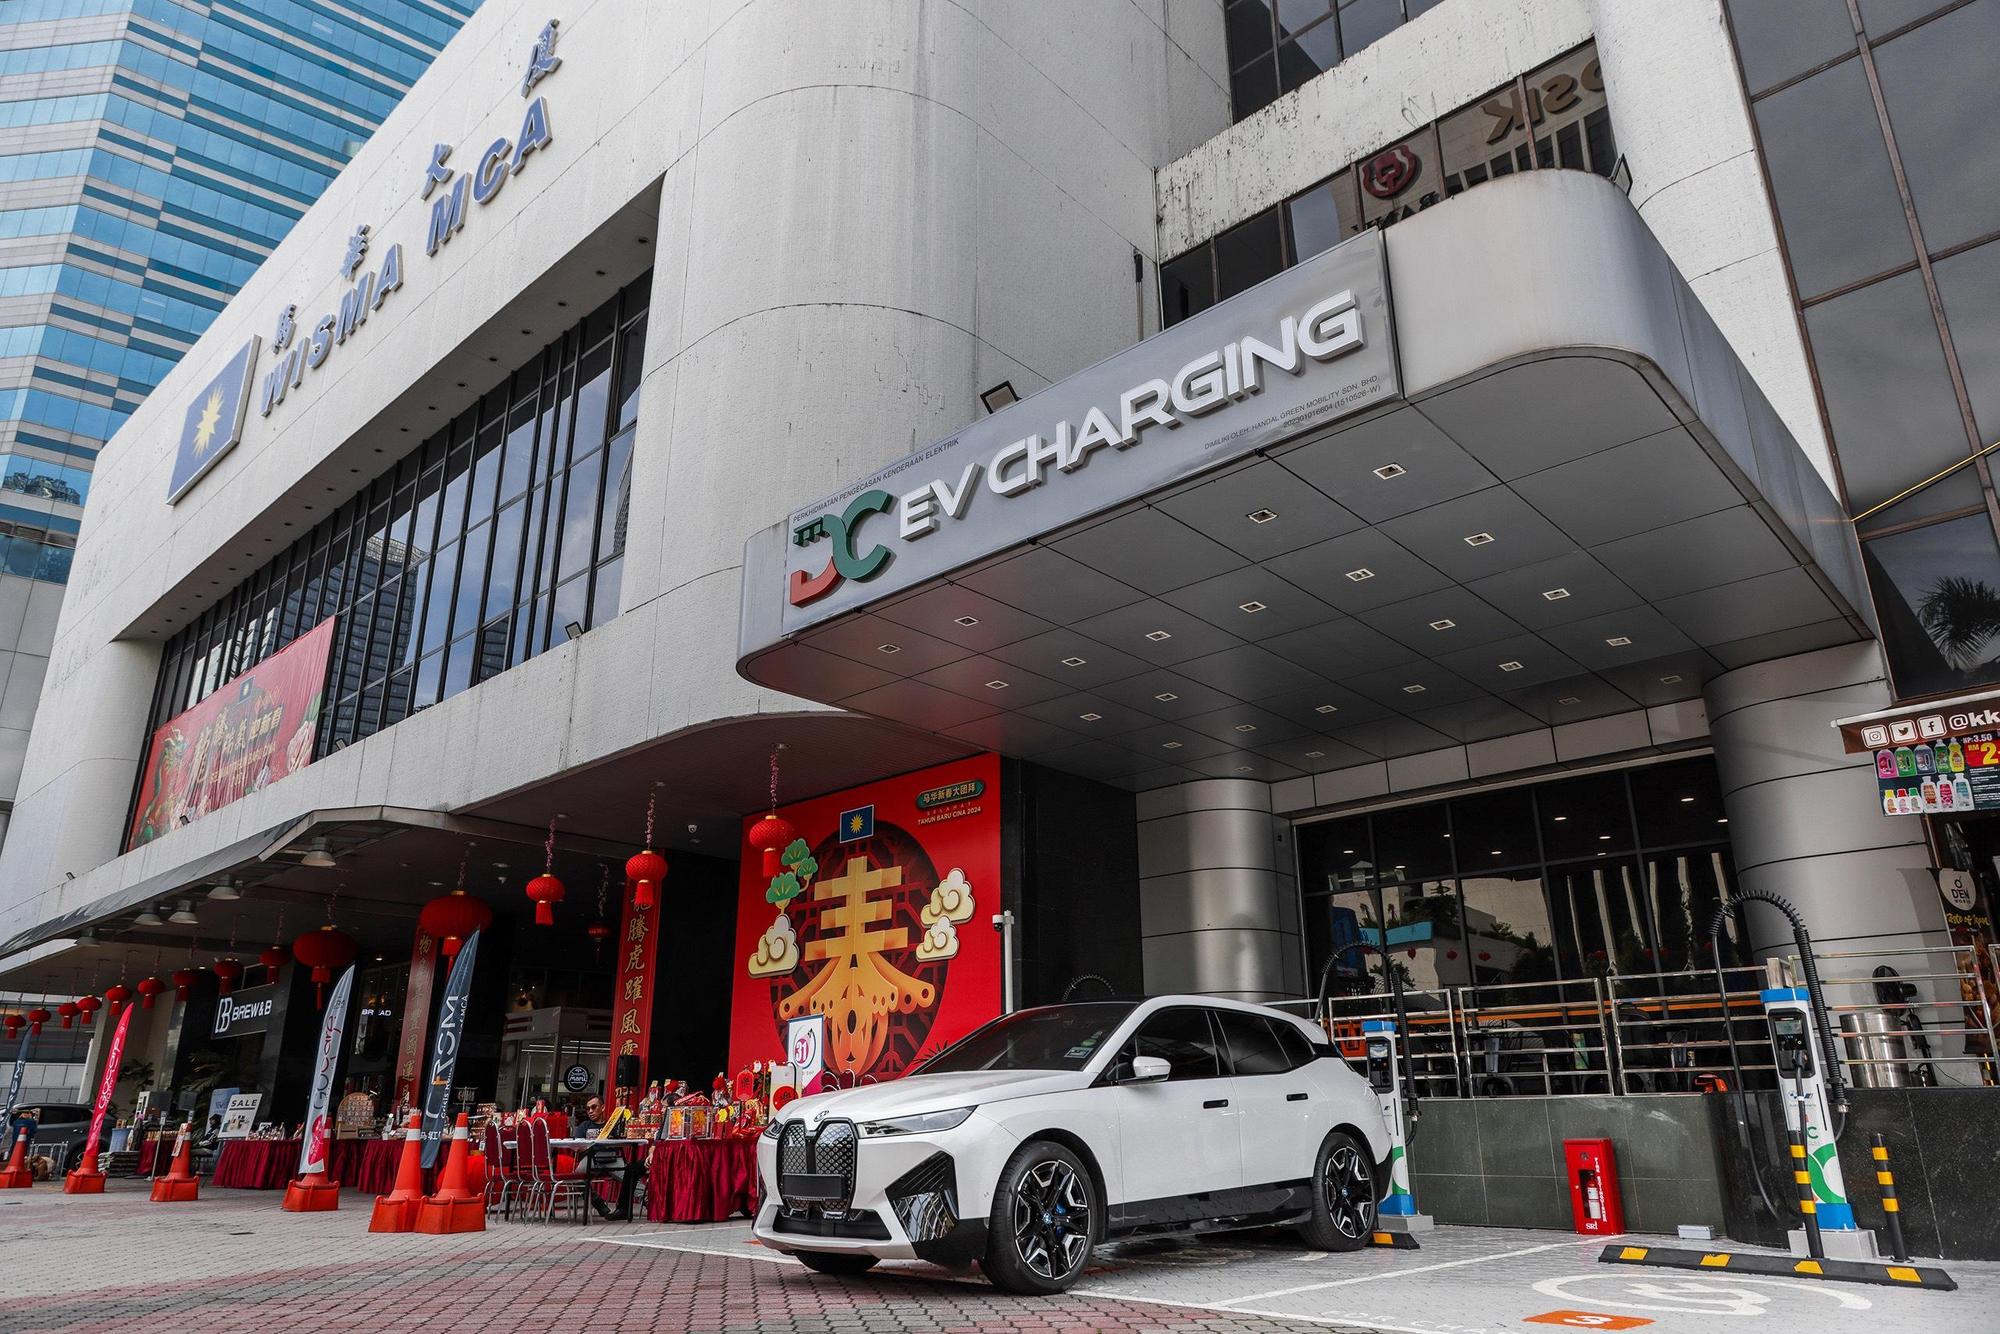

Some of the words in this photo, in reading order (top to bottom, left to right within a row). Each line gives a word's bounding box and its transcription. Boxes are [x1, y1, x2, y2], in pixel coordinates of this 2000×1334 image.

[260, 243, 403, 418] WISMA
[426, 96, 553, 257] MCA
[900, 462, 984, 541] EV
[987, 288, 1364, 496] CHARGING
[1280, 405, 1305, 419] GREEN
[1306, 390, 1340, 411] MOBILITY
[838, 476, 882, 501] PENGECASAN
[882, 455, 924, 479] KENDERAAN
[925, 438, 959, 460] ELEKTRIK
[1981, 742, 2000, 765] 2
[923, 782, 976, 803] 马华新春大团拜
[918, 817, 936, 825] TAHUN
[936, 813, 952, 821] BARU
[952, 810, 966, 818] CINA
[967, 806, 981, 815] 2024
[361, 1008, 392, 1016] BRAD
[230, 1099, 257, 1107] SALE
